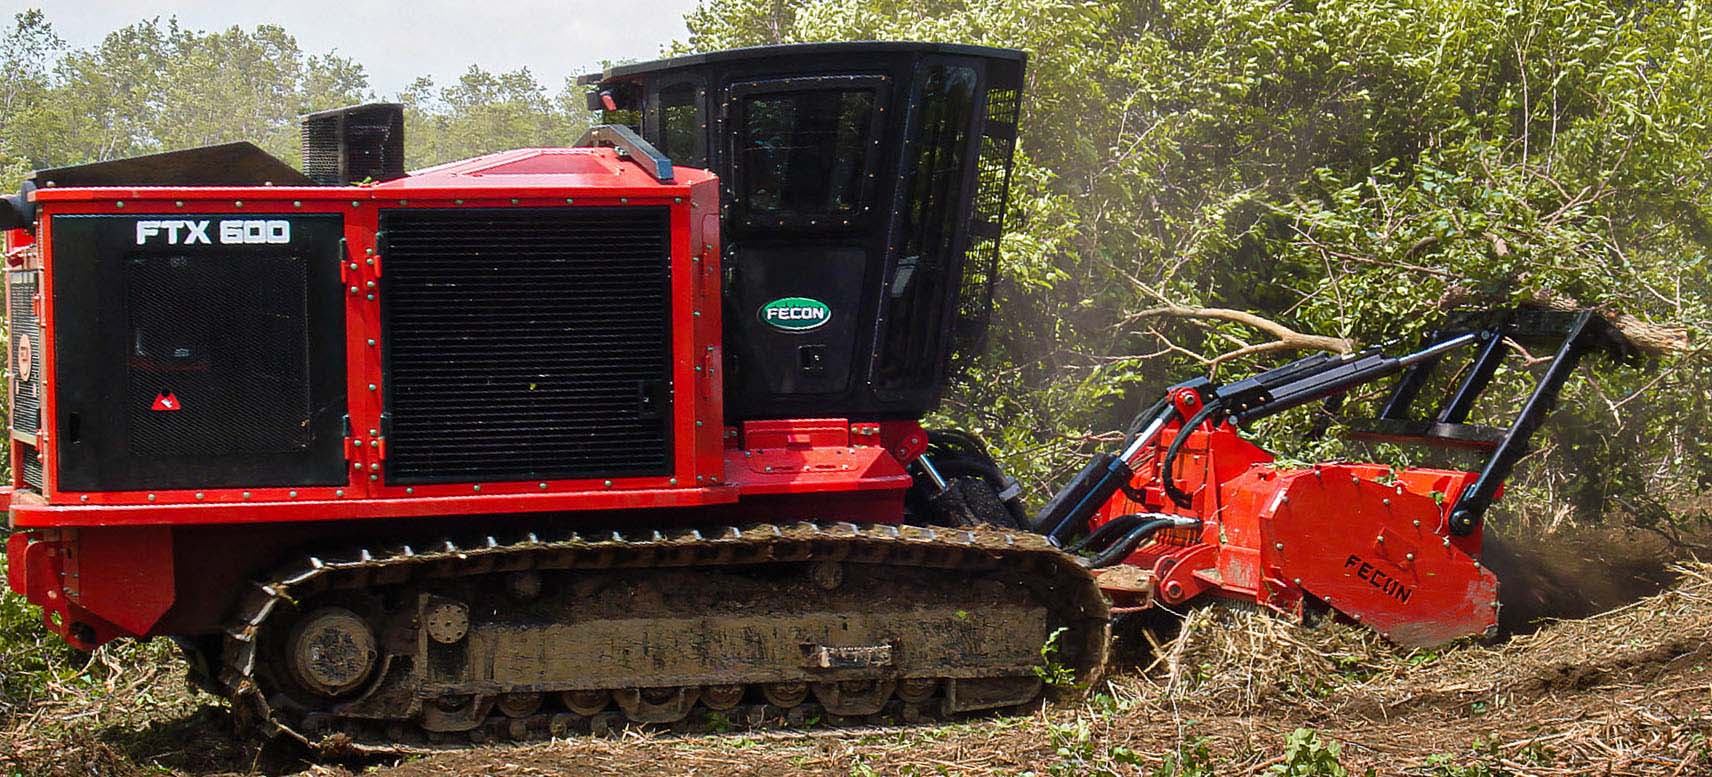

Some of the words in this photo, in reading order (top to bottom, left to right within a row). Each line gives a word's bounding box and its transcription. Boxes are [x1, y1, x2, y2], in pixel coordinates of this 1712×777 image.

[136, 220, 212, 245] FTX
[219, 219, 291, 245] 600
[767, 307, 824, 320] FECON
[1344, 554, 1412, 603] FECON
